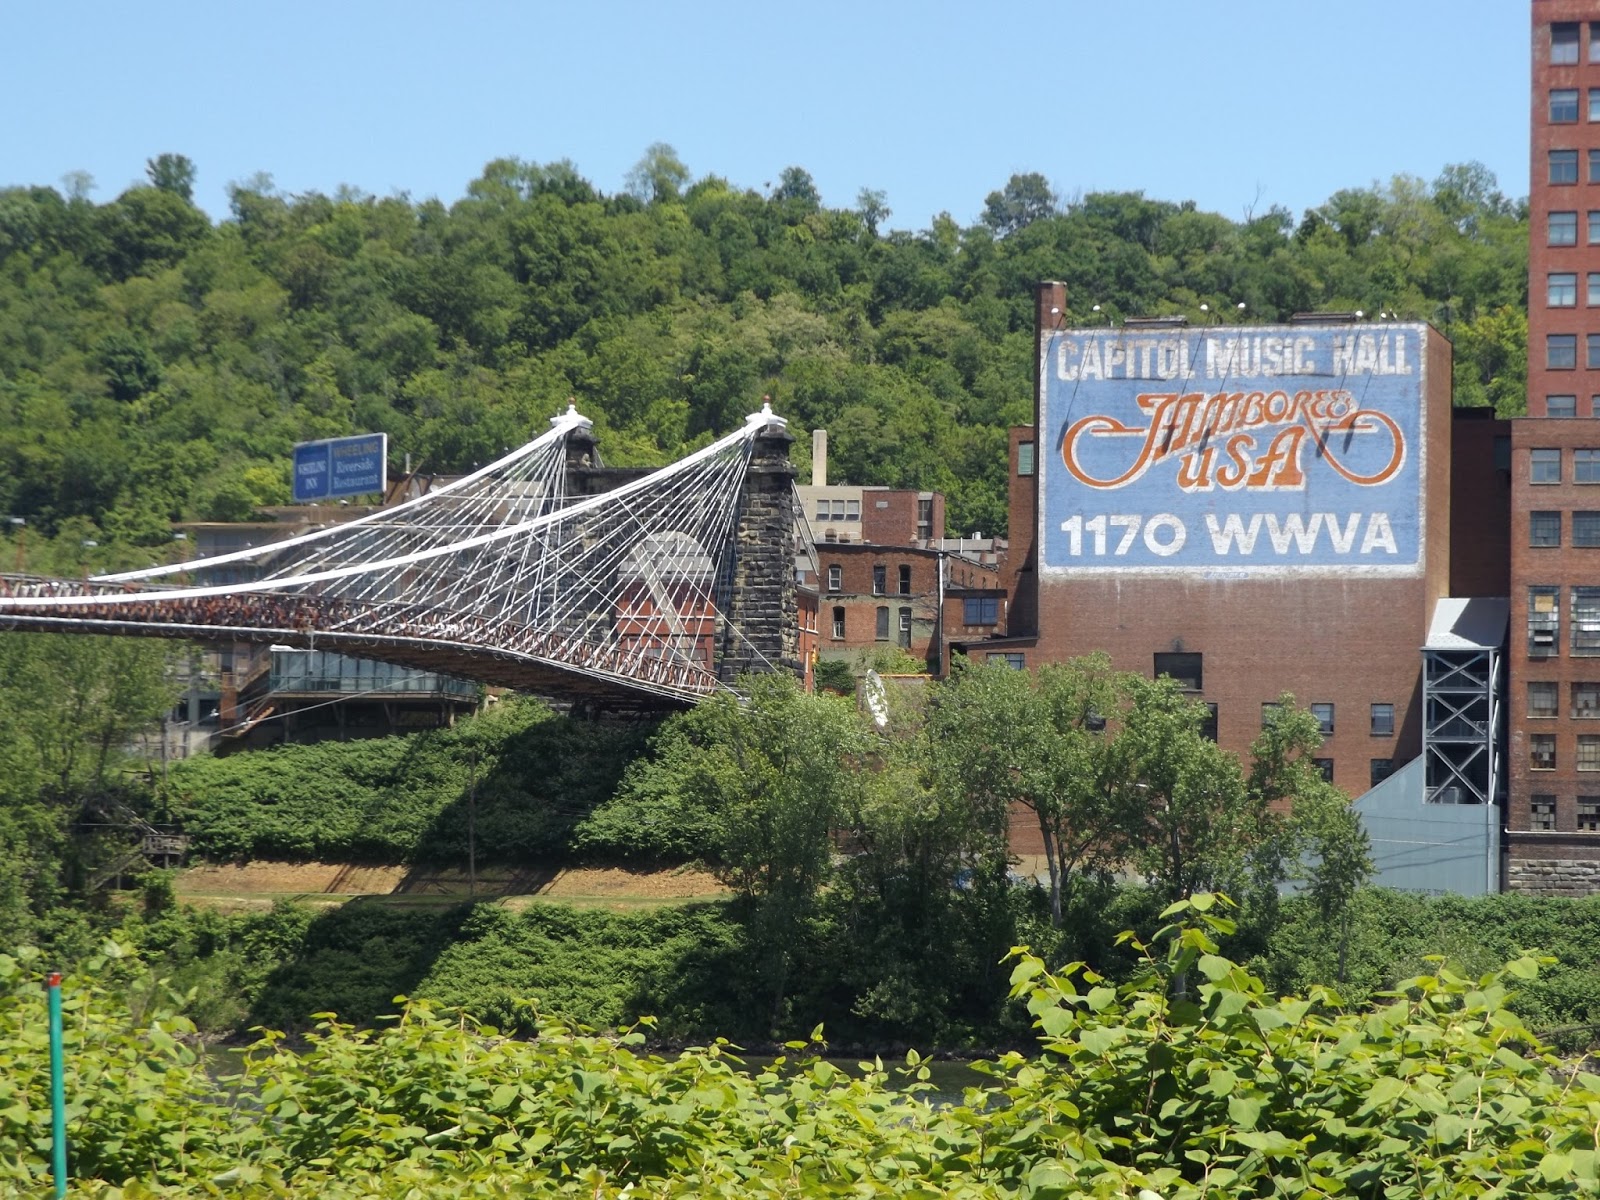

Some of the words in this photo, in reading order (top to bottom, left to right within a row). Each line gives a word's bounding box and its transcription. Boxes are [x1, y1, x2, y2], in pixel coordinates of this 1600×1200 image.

[1056, 339, 1196, 381] CAPITOL
[1332, 333, 1414, 375] HALL
[1061, 513, 1187, 557] 1170
[1206, 512, 1398, 556] WWVA
